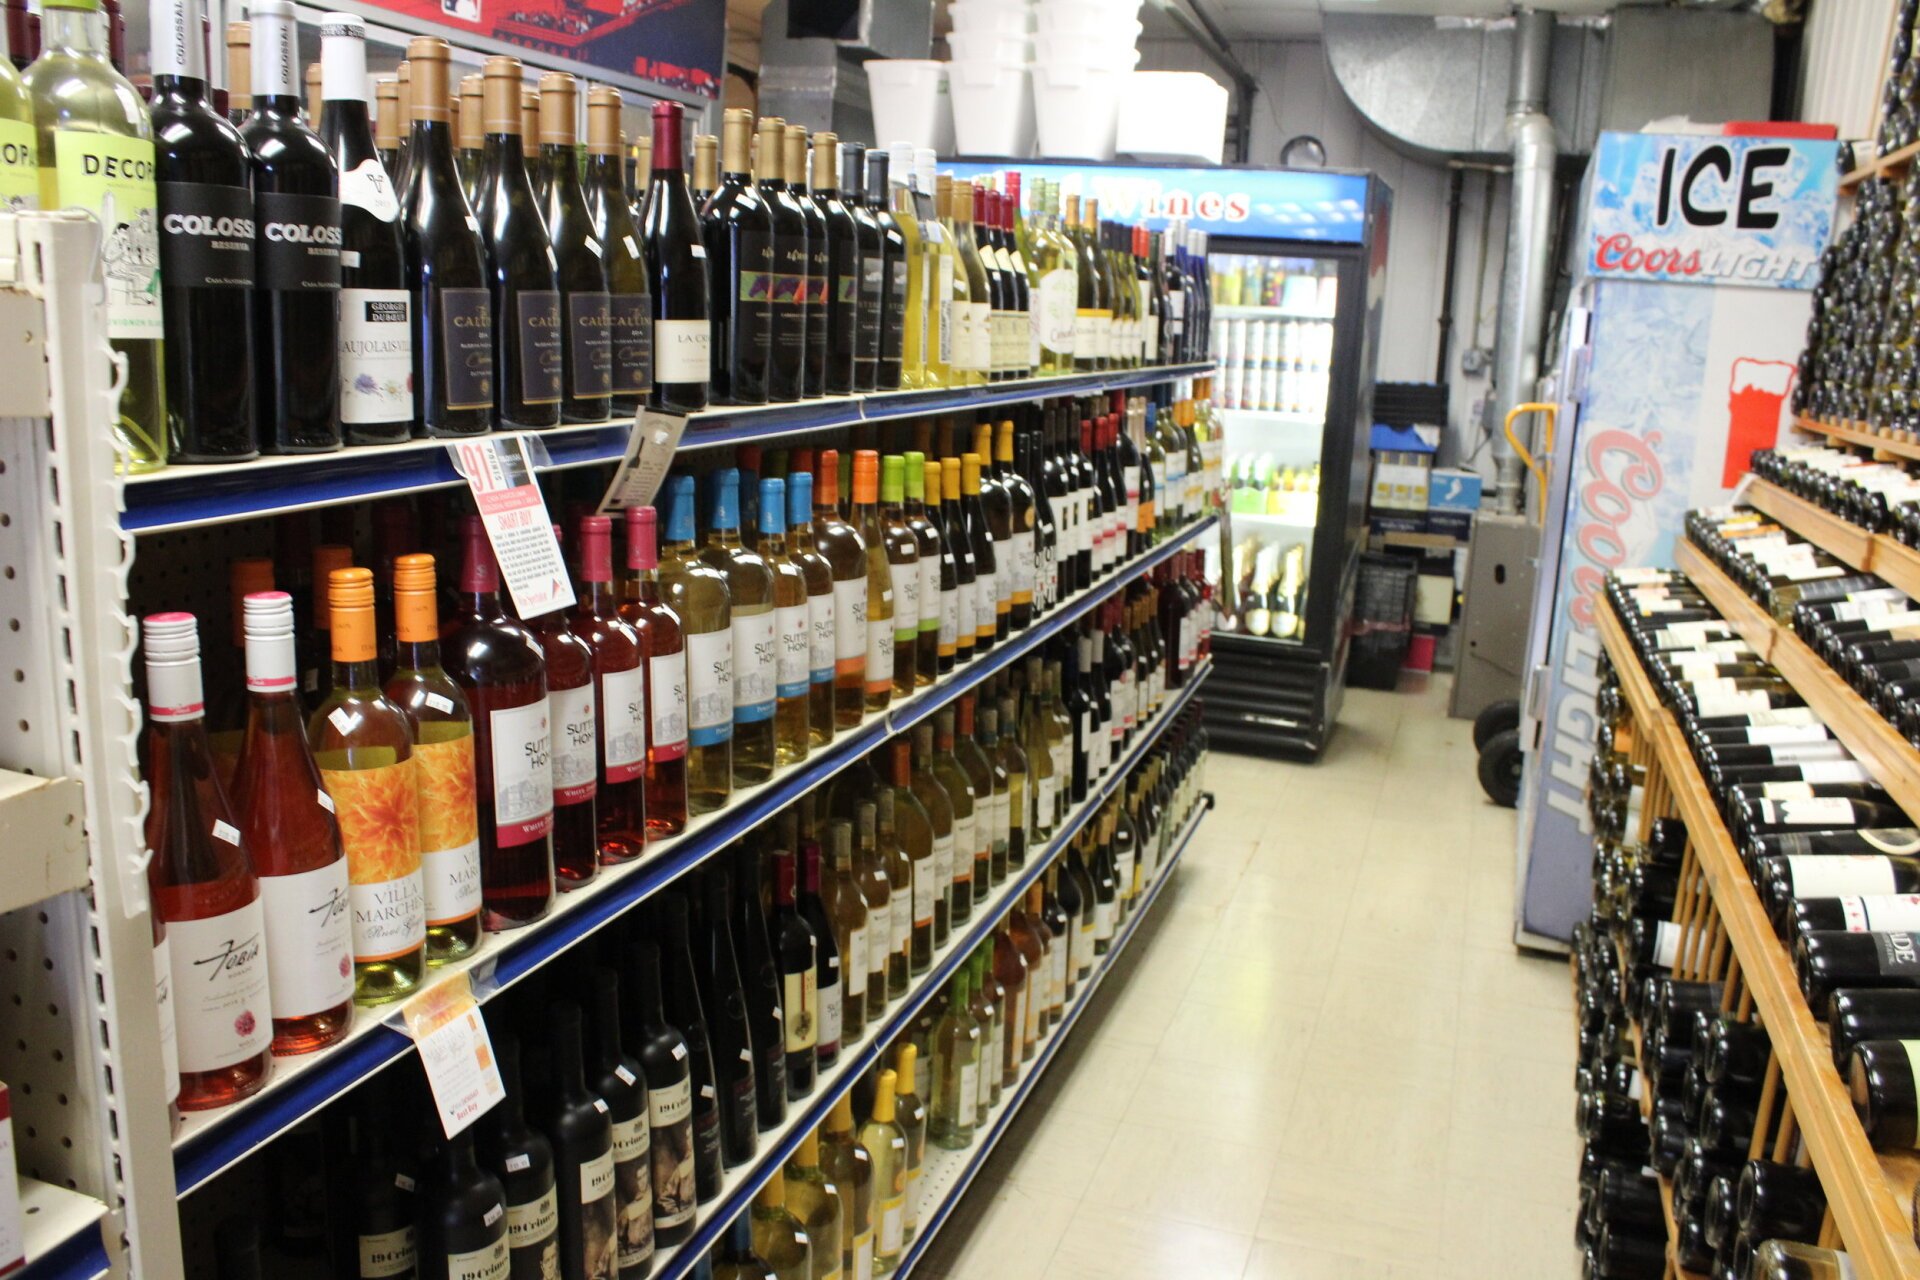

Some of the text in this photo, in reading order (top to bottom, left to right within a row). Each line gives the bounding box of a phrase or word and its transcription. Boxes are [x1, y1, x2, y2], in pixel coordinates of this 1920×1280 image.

[280, 25, 290, 84] COLOSSAL
[1096, 177, 1246, 221] Wines
[1656, 145, 1791, 229] ICE
[1596, 233, 1817, 281] Coors LIGHT
[462, 443, 496, 493] 91
[374, 883, 418, 906] VILLA
